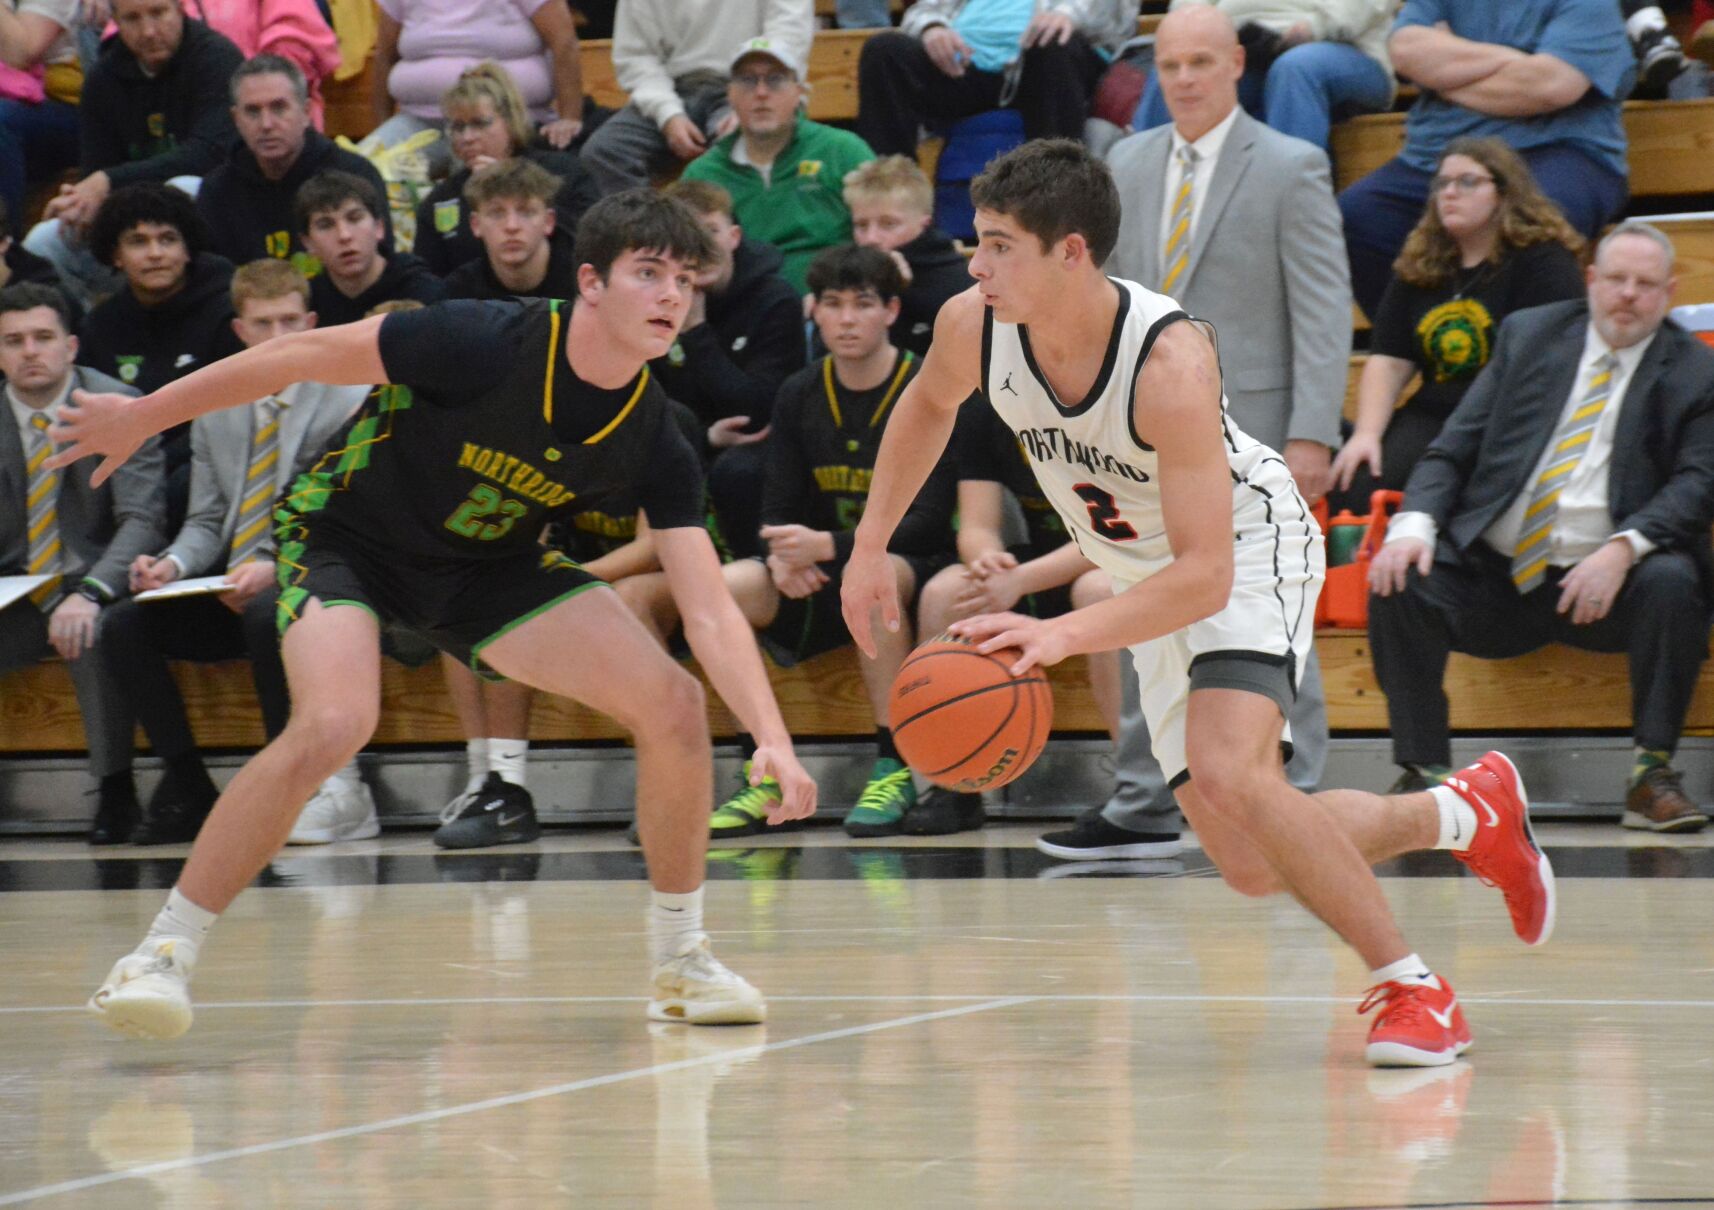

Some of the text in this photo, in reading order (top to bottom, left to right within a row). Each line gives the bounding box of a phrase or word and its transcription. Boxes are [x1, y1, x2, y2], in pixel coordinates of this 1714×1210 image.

[1016, 427, 1150, 483] ORTHWOOD
[444, 482, 529, 541] 23
[1071, 483, 1139, 542] 2
